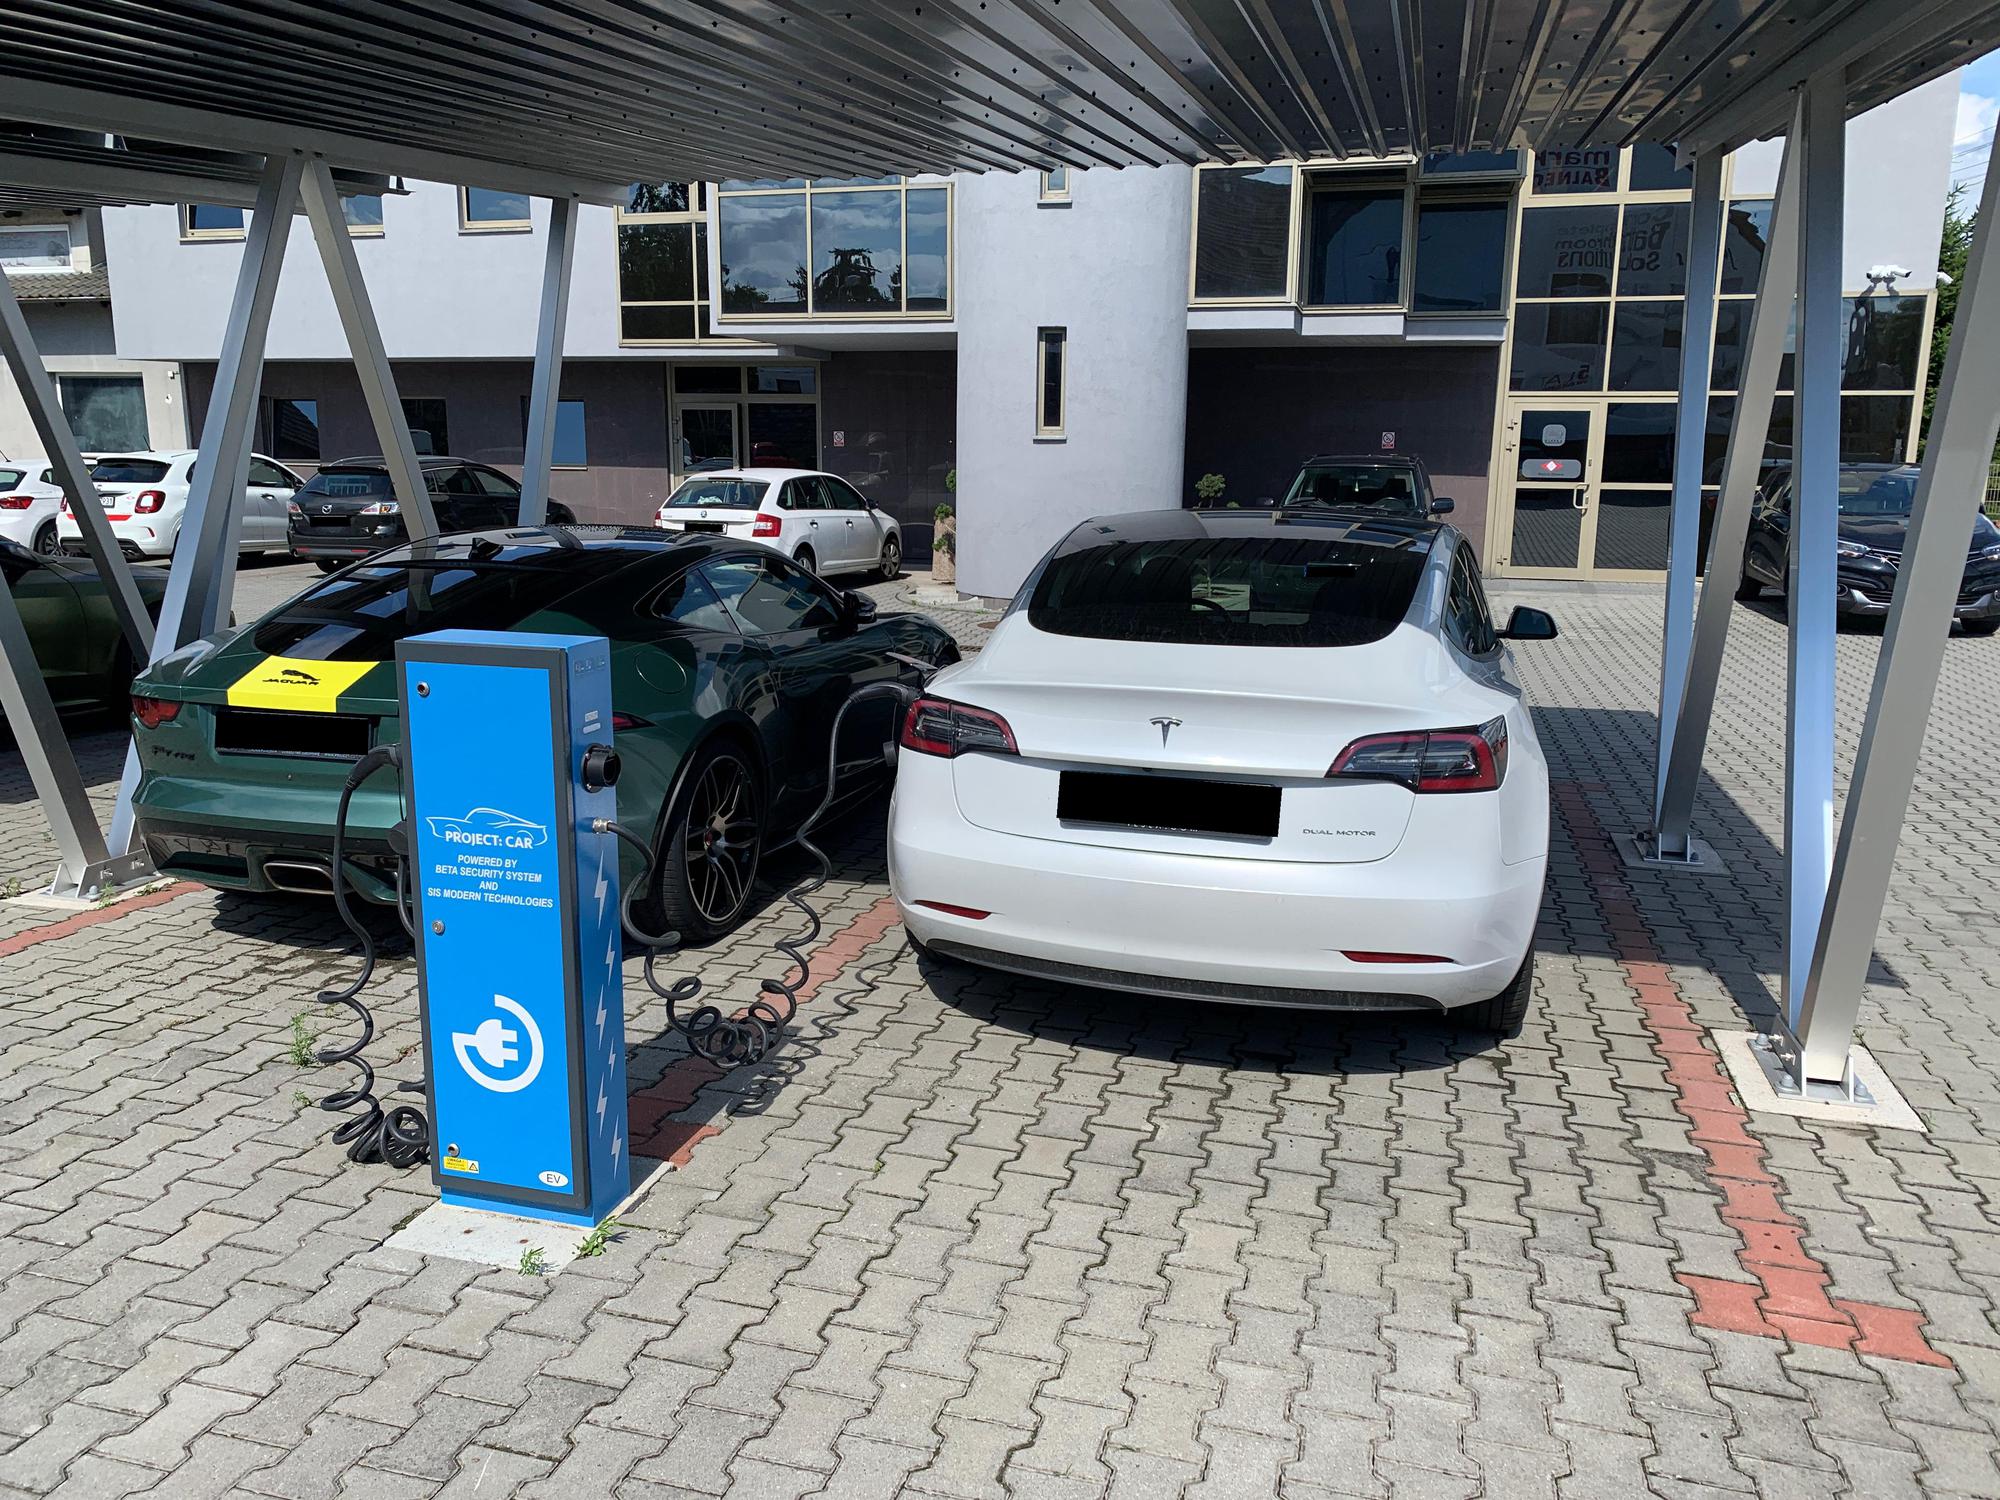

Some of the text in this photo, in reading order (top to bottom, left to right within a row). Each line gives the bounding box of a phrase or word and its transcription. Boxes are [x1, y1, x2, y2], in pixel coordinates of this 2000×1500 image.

[262, 678, 319, 686] JAGUAR
[1302, 828, 1377, 837] DUAL MOTOR
[445, 830, 533, 849] PROJECT: CAR
[457, 854, 518, 868] POWERED BY
[435, 864, 542, 883] BETA SECURITY SYSTEM
[479, 880, 499, 891] AND
[427, 888, 553, 908] SIS MODERN TECHNOLOGIES
[546, 1173, 561, 1184] EV
